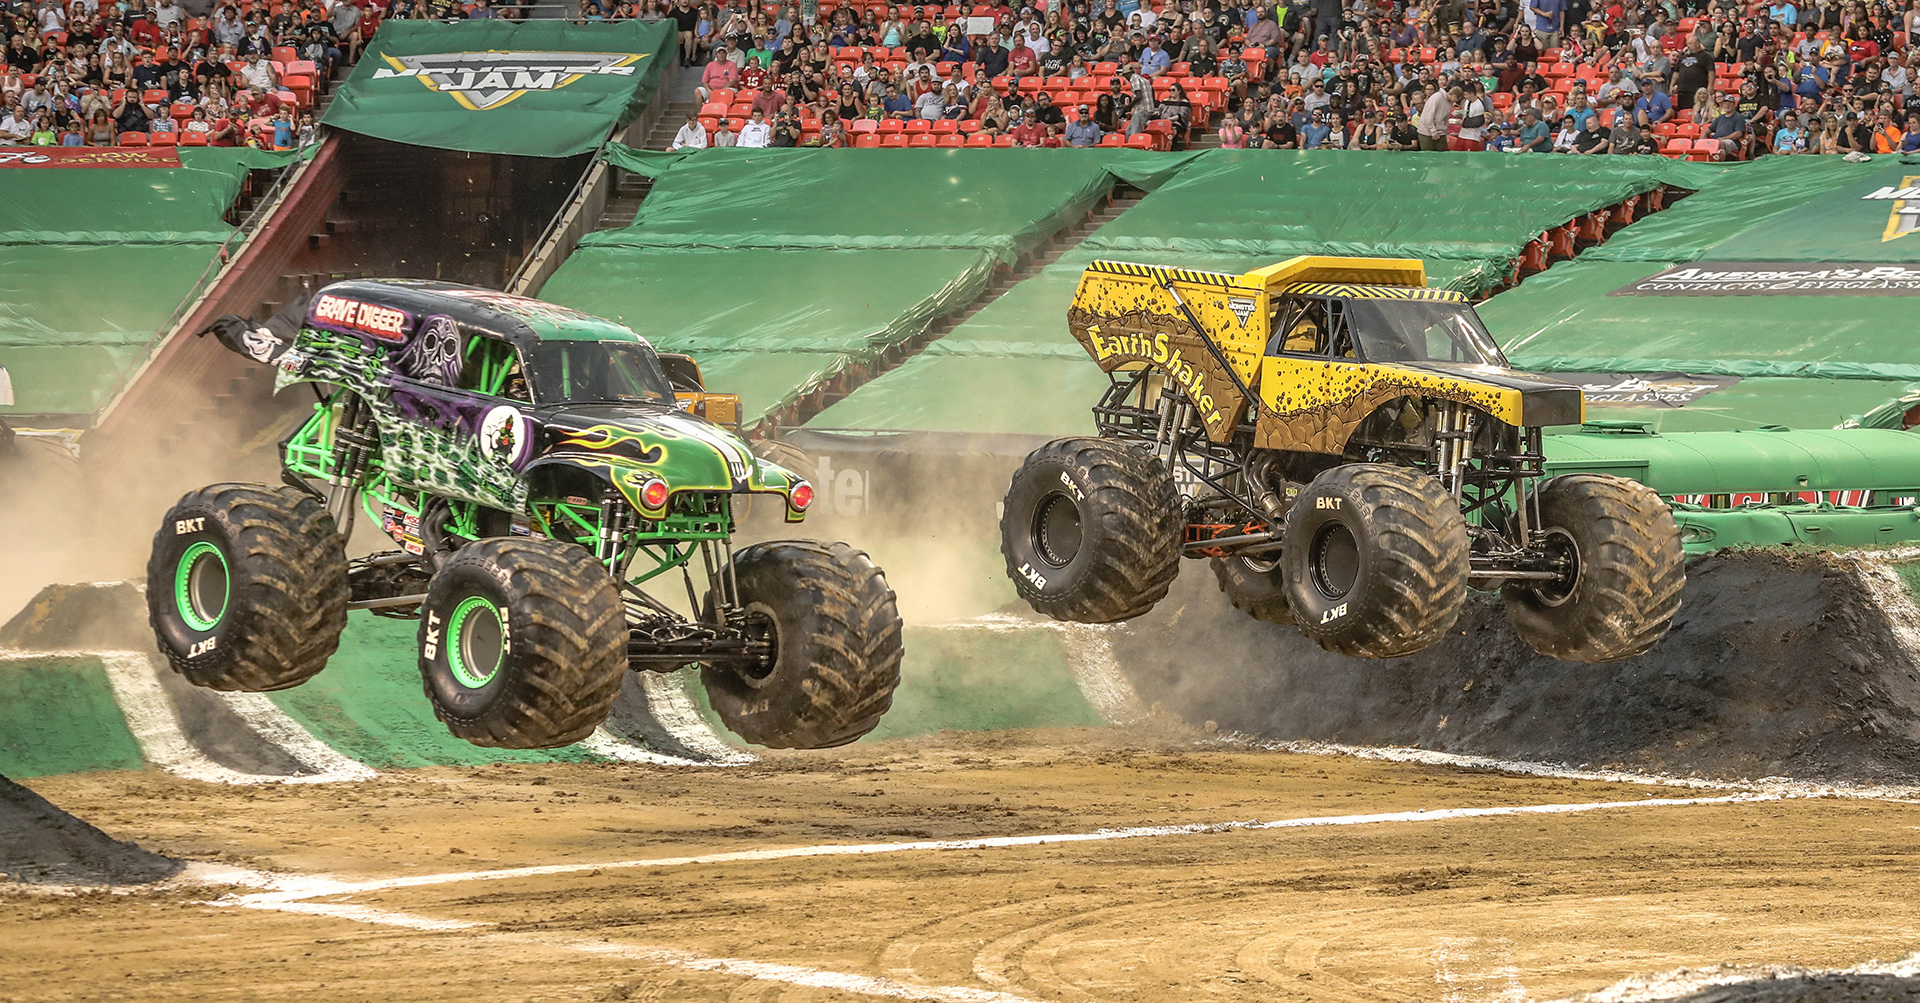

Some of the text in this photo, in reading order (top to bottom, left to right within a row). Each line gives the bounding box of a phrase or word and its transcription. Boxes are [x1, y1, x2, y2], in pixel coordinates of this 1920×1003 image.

[438, 71, 559, 91] JAM
[747, 76, 759, 87] 15
[1636, 281, 1770, 290] CONTACTS
[1797, 280, 1920, 290] EYEGLASS
[315, 294, 405, 336] GRAVE DIGGER
[1060, 471, 1085, 502] BKT
[1316, 497, 1342, 510] BKT
[175, 517, 206, 535] BKT
[1017, 562, 1048, 591] BKT
[1320, 602, 1348, 624] BKT
[424, 609, 441, 661] BKT
[499, 606, 512, 656] BKT
[187, 636, 217, 659] BKT
[740, 699, 769, 717] BKT
